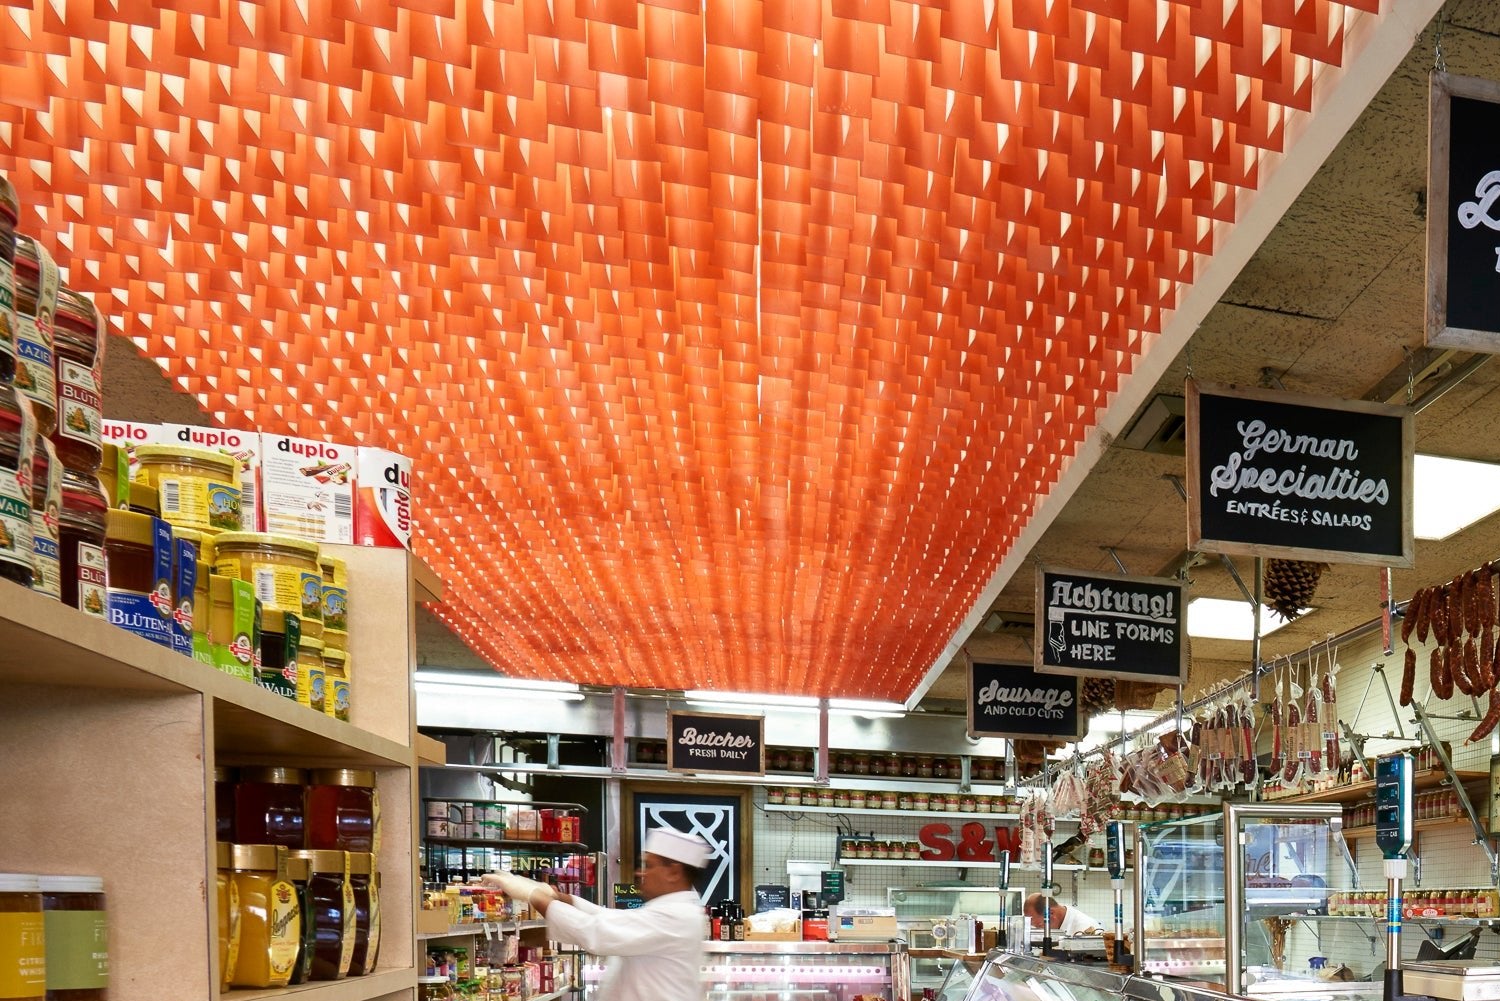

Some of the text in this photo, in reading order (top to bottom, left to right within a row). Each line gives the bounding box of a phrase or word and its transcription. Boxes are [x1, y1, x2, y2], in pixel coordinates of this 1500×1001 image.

[177, 427, 241, 447] duplo
[1236, 419, 1359, 461] German
[277, 438, 339, 460] duplo
[1209, 451, 1391, 506] Specialties
[1226, 499, 1299, 524] ENTRÉES
[1310, 509, 1372, 531] SALADS
[1049, 580, 1174, 619] Achtung!
[1070, 619, 1174, 644] LINE FORMS
[1070, 643, 1116, 661] HERE
[978, 679, 1073, 710] Sausage
[984, 705, 1065, 719] AND COLD CUTS
[678, 727, 756, 748] Butcher
[689, 748, 748, 760] FRESH DAILY
